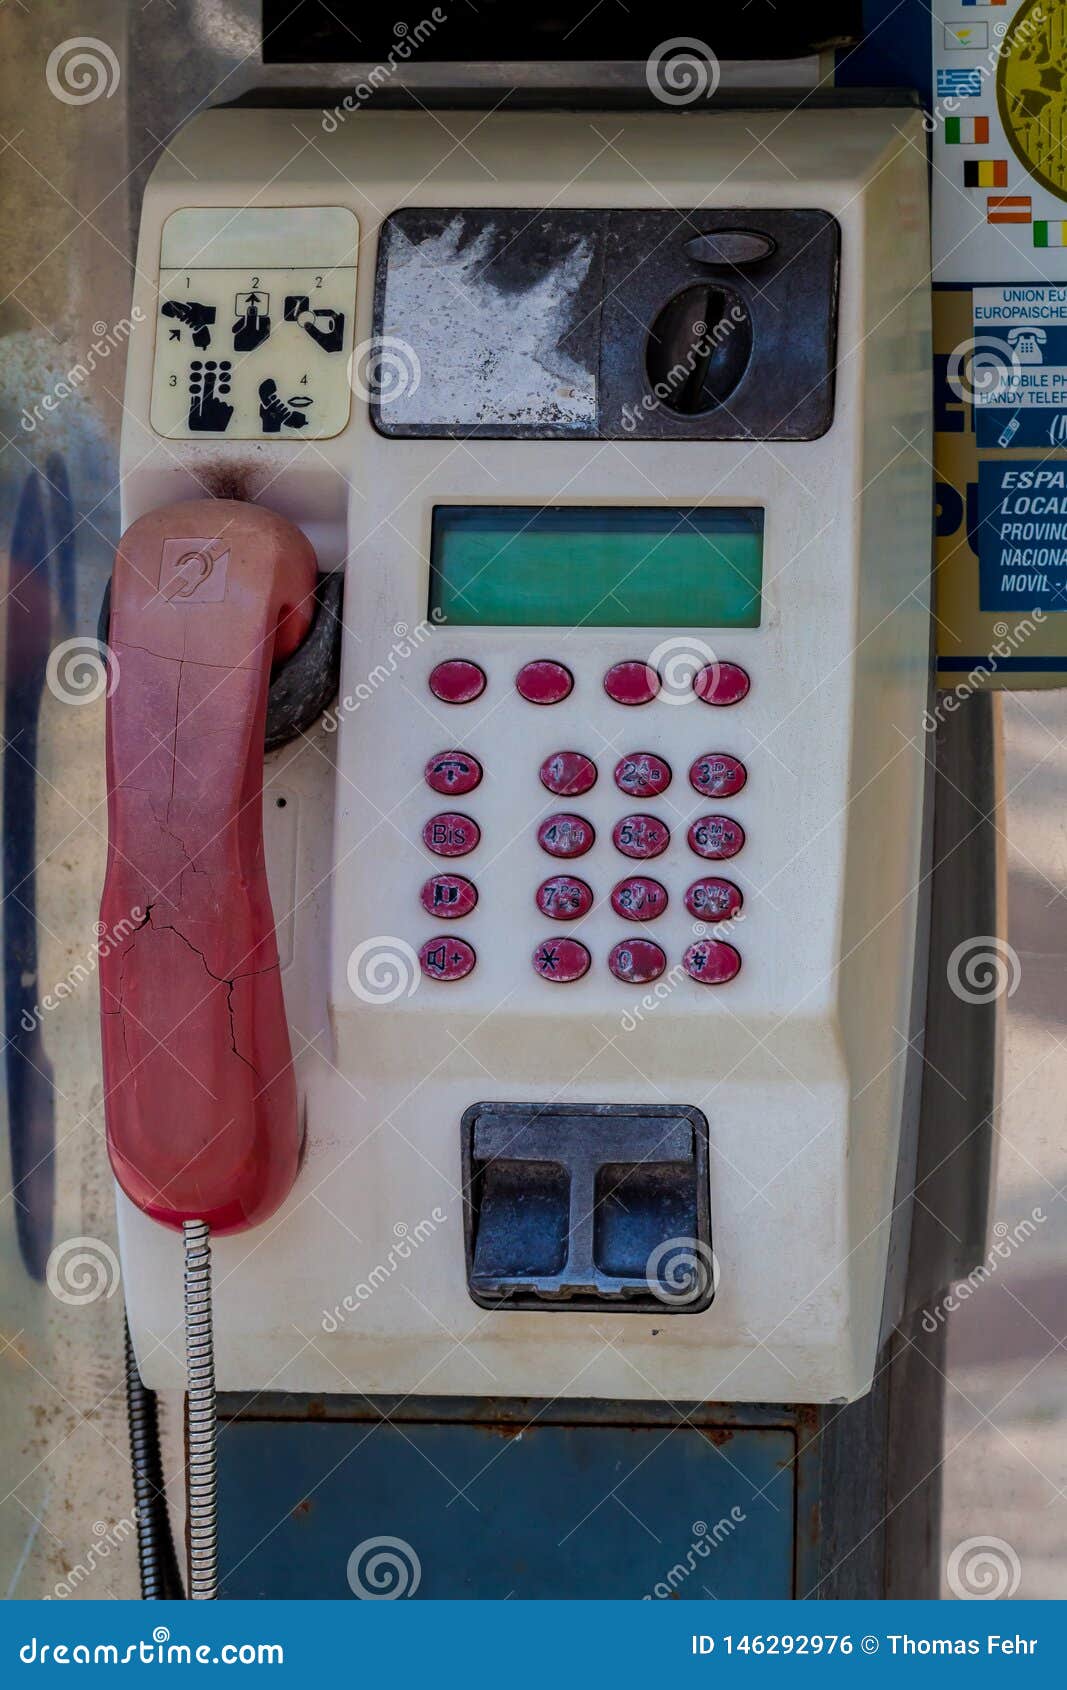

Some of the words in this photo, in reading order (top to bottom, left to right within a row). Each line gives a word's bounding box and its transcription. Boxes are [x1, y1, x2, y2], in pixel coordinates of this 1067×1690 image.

[185, 277, 190, 288] 1
[251, 277, 260, 288] 2
[315, 276, 323, 288] 2
[1003, 289, 1045, 302] UNION
[975, 306, 1067, 319] EUROPAISCHE
[169, 375, 177, 387] 3
[300, 373, 308, 386] 4
[1001, 375, 1049, 387] MOBILE
[980, 391, 1024, 404] HANDY
[1001, 471, 1067, 489] ESPA
[1001, 574, 1050, 592] MOVIL
[622, 763, 636, 782] 2
[698, 763, 711, 783] 3
[432, 824, 465, 844] Bis
[544, 825, 557, 843] 4
[620, 825, 633, 844] 5
[695, 826, 709, 845] 6
[544, 887, 557, 906] 7
[620, 888, 633, 907] 8
